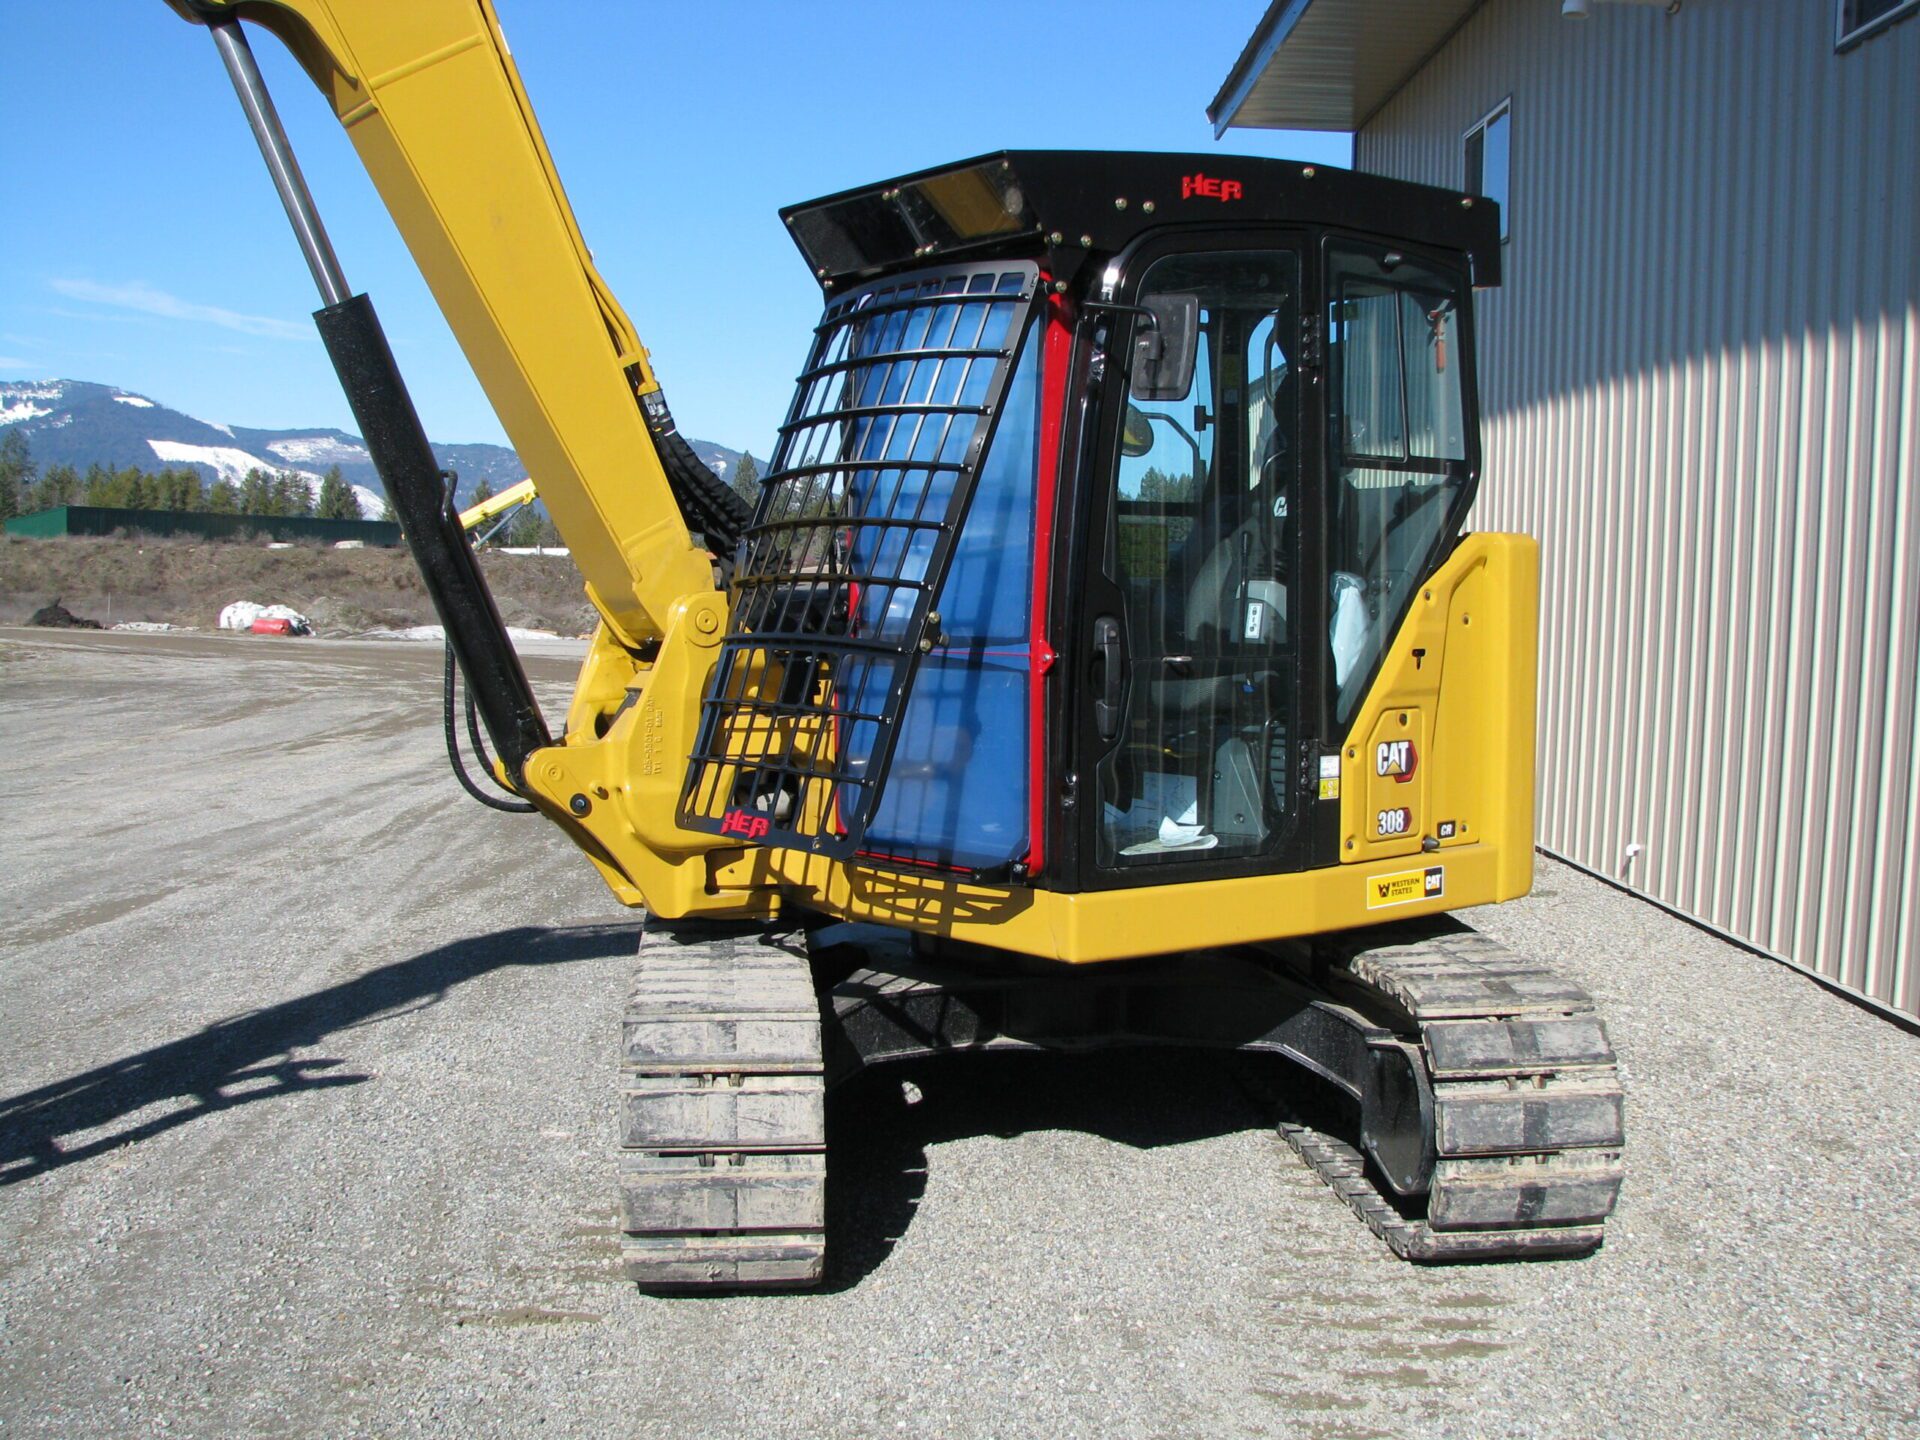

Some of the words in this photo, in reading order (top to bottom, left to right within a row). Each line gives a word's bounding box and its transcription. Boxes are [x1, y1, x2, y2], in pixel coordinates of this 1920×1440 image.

[1377, 741, 1409, 776] CAT
[1378, 809, 1405, 835] 308
[1391, 878, 1420, 888] WESTERN
[1425, 874, 1442, 890] CAT
[1391, 887, 1413, 896] STATES
